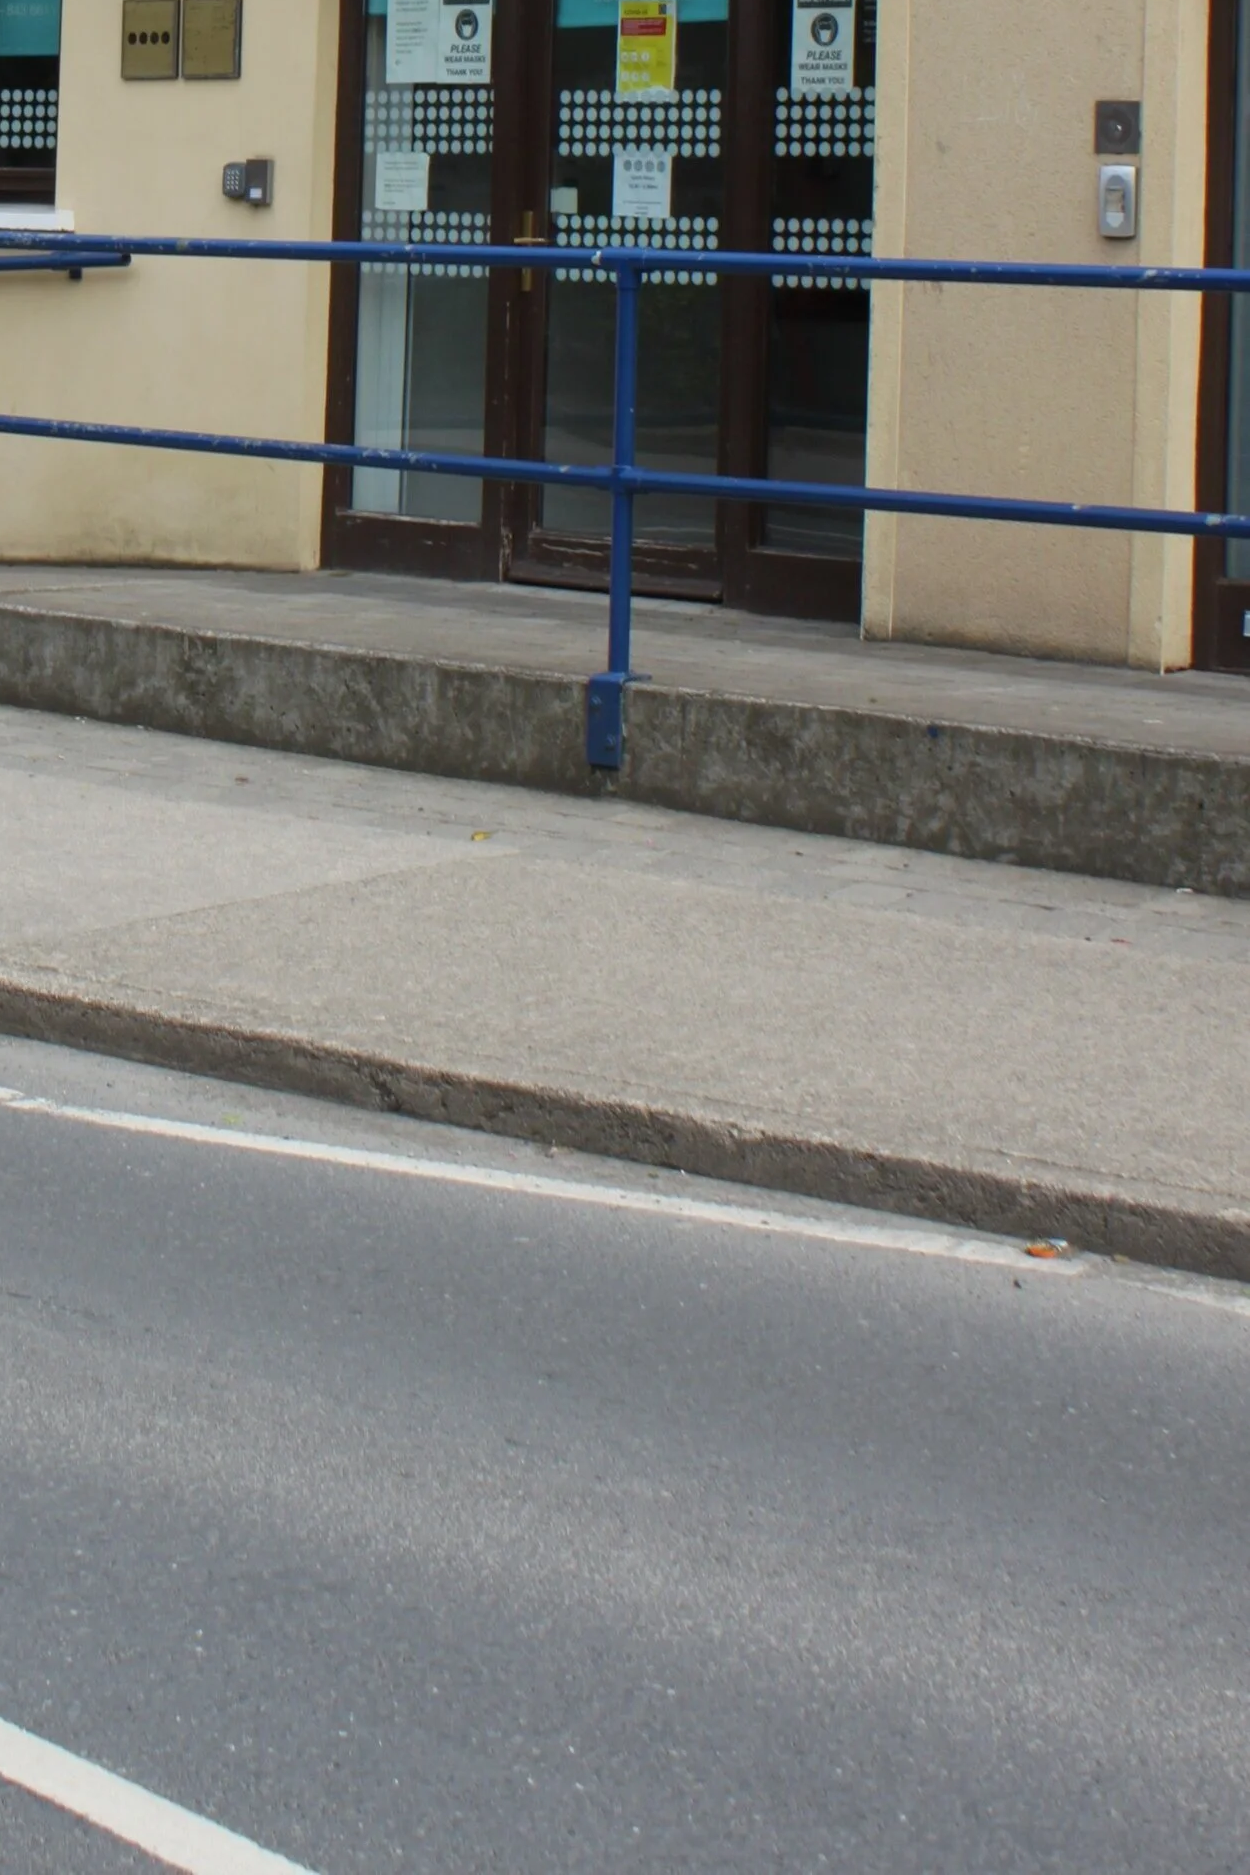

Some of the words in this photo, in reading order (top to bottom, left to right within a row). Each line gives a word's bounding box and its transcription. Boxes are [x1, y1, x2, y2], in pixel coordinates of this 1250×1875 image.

[450, 44, 482, 54] PLEASE
[444, 55, 463, 64] WEAR
[464, 55, 486, 63] MASKS
[806, 50, 842, 61] PLEASE
[798, 63, 821, 71] WEAR
[822, 63, 848, 71] MASKS
[446, 68, 467, 76] THANK
[801, 77, 826, 85] THANK
